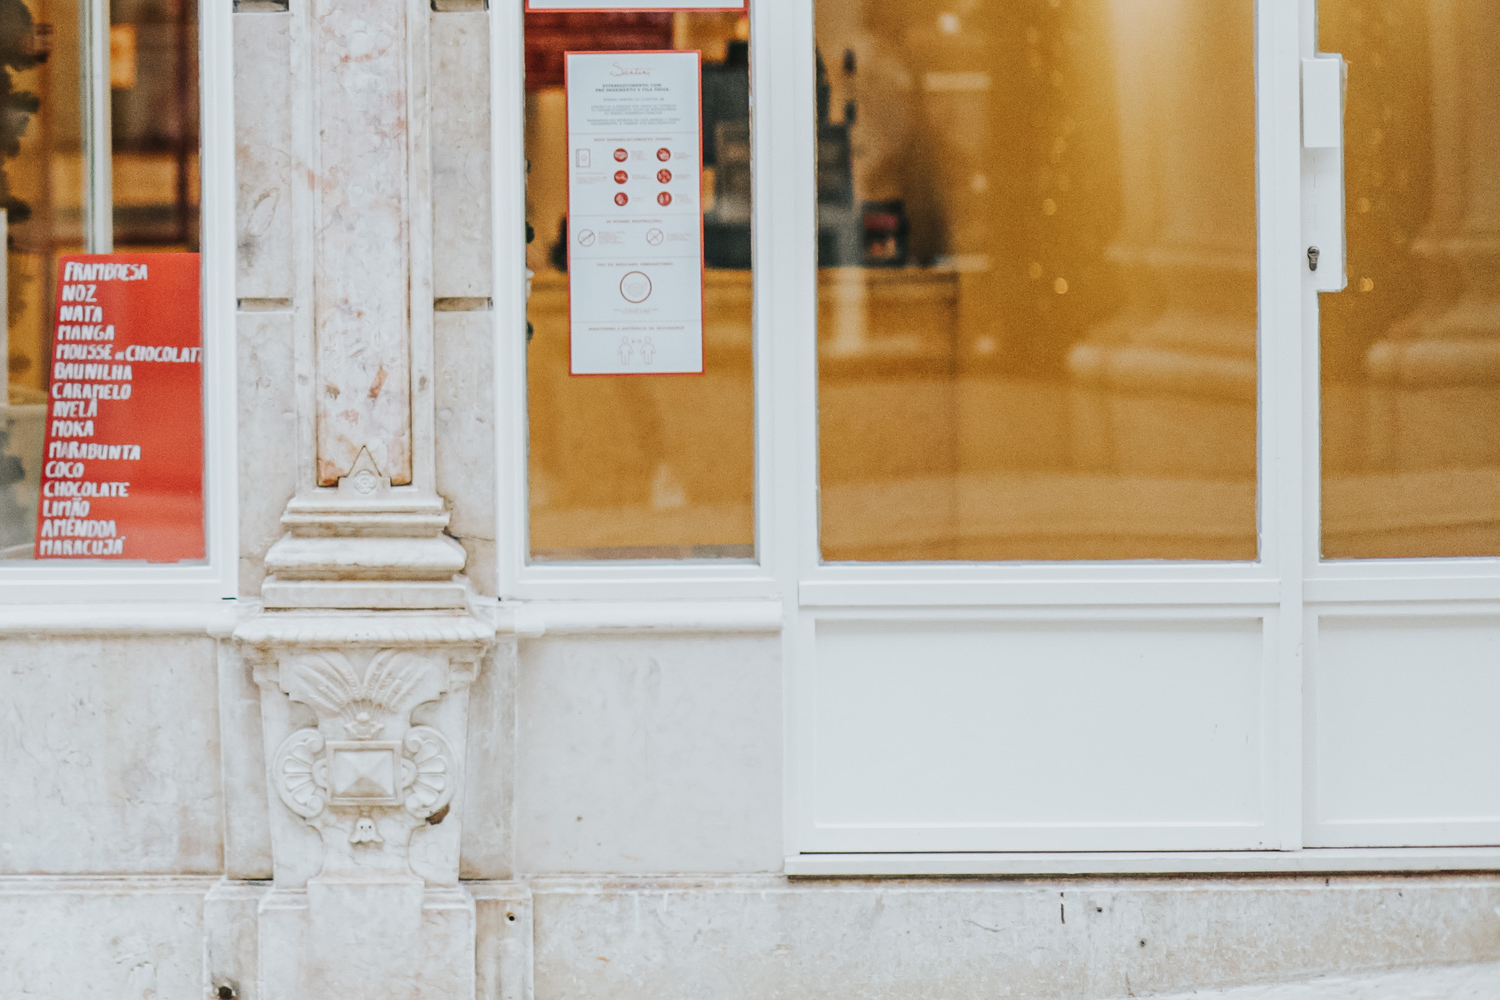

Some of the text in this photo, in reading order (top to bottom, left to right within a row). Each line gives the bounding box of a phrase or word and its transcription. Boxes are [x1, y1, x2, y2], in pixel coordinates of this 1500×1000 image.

[63, 261, 149, 282] FRAMBOESA
[61, 284, 98, 303] NOZ
[59, 305, 103, 323] NATA
[57, 324, 115, 341] MANGA
[56, 343, 113, 360] MOUSSE
[54, 361, 133, 381] BAUNILHA
[51, 382, 132, 400] CARAMELO
[51, 419, 95, 438] MOKA
[48, 441, 142, 461] MARABUNTA
[45, 461, 85, 479] COCO
[43, 481, 131, 498] CHOCOLATE
[42, 497, 91, 518] LIMÃO
